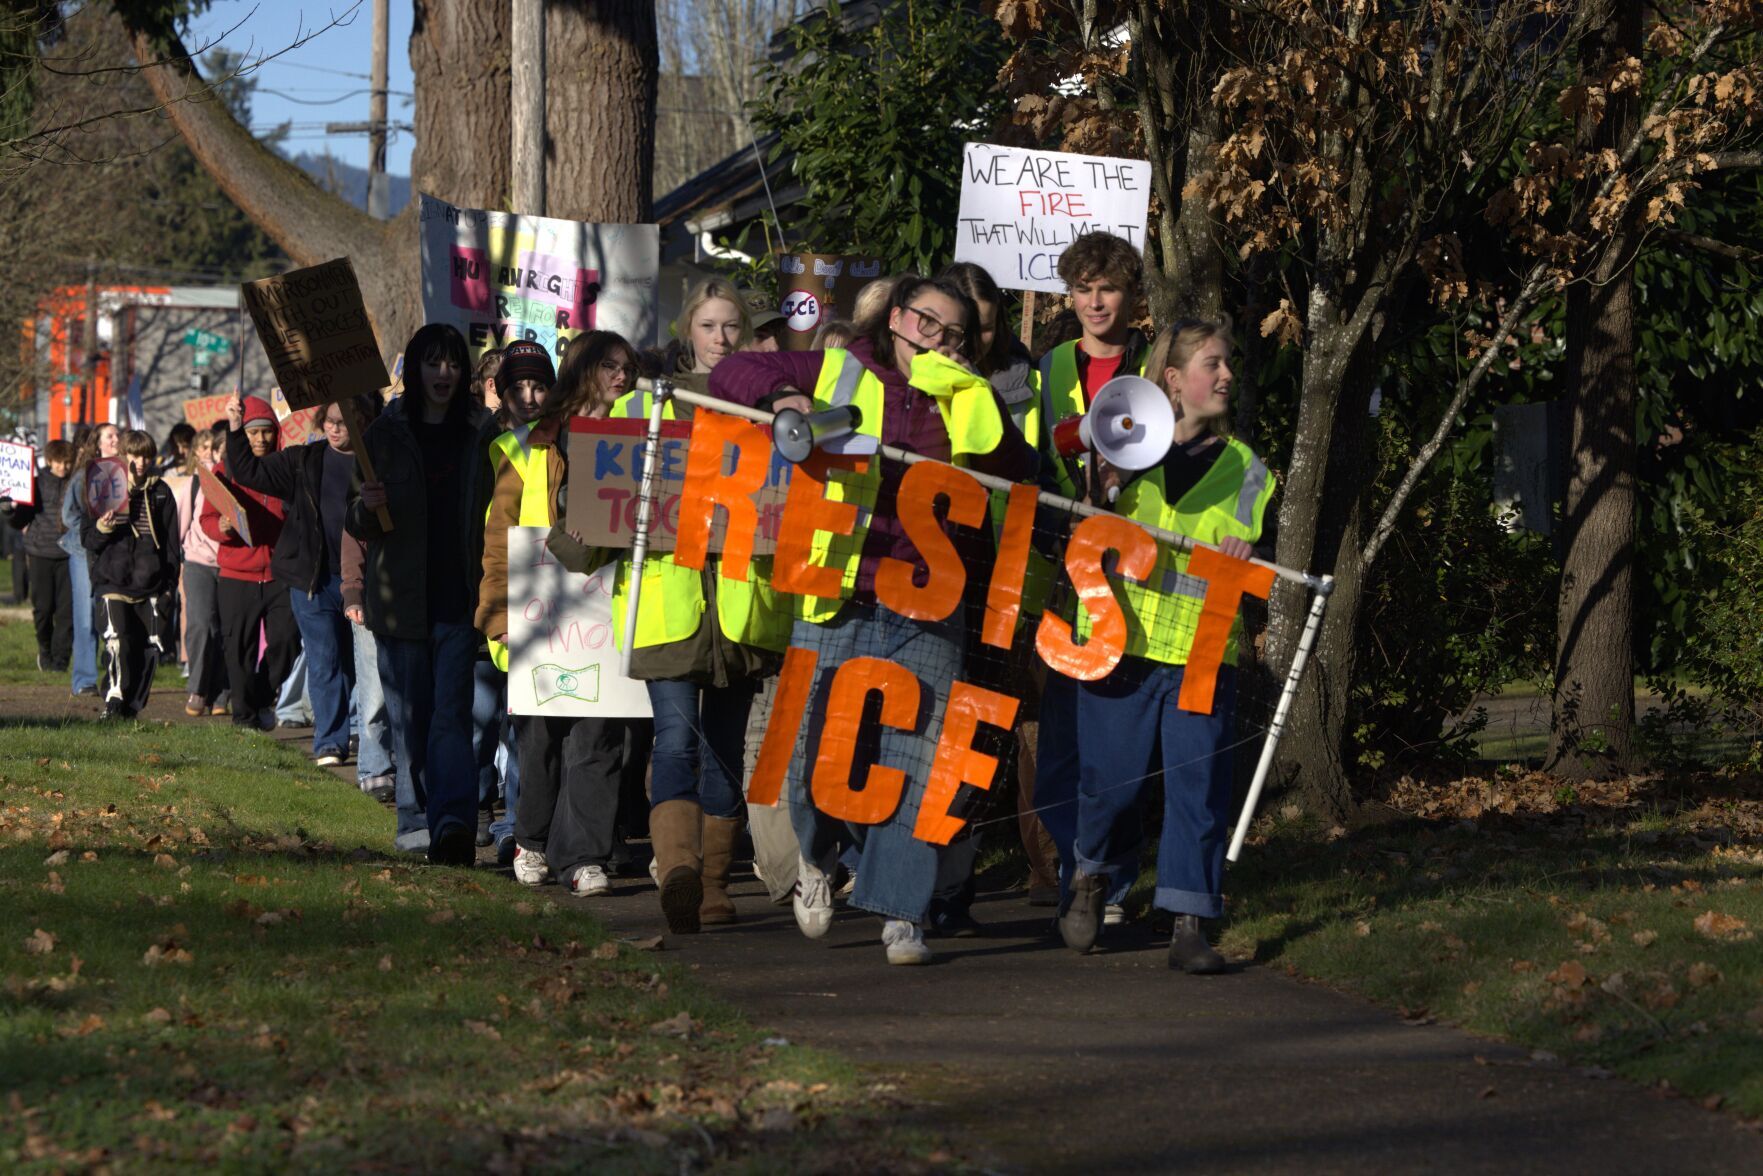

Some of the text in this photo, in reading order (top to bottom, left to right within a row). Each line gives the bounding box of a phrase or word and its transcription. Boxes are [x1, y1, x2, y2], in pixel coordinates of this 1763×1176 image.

[968, 151, 1138, 191] WE ARE THE
[1018, 190, 1092, 217] FIRE
[960, 218, 1013, 245] THAT
[1014, 217, 1068, 246] WILL
[311, 288, 354, 314] OUT
[784, 301, 815, 316] ICE
[529, 302, 570, 330] FOR
[263, 327, 303, 350] DUE
[673, 407, 1276, 715] RESIST
[746, 646, 1021, 847] ICE
